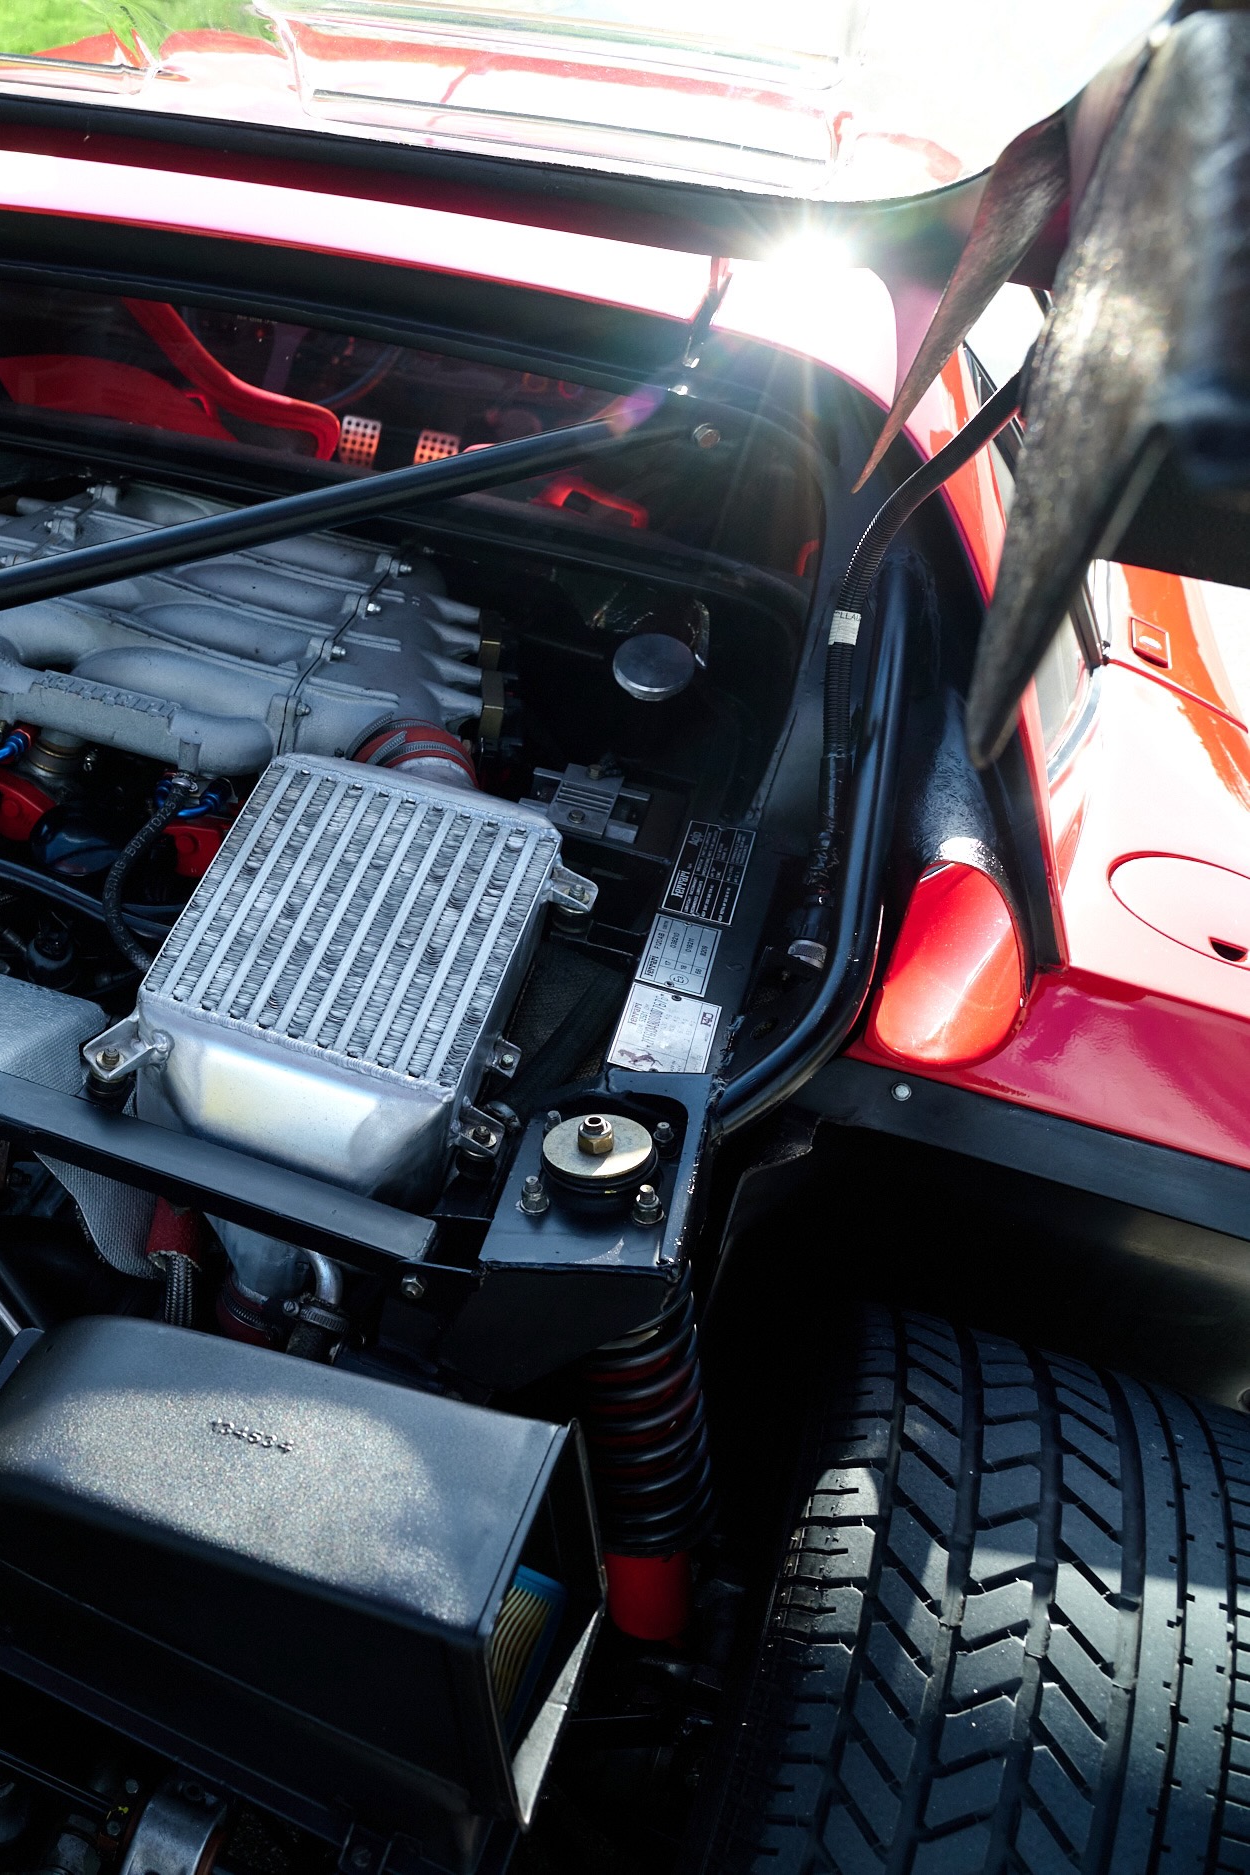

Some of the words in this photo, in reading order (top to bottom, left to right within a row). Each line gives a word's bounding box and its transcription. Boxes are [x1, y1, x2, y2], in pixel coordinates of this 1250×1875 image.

[672, 869, 690, 898] Ferrari
[688, 831, 704, 846] Agip
[644, 955, 658, 976] Ferrari
[628, 1002, 642, 1024] Ferrari
[700, 1011, 713, 1026] F40
